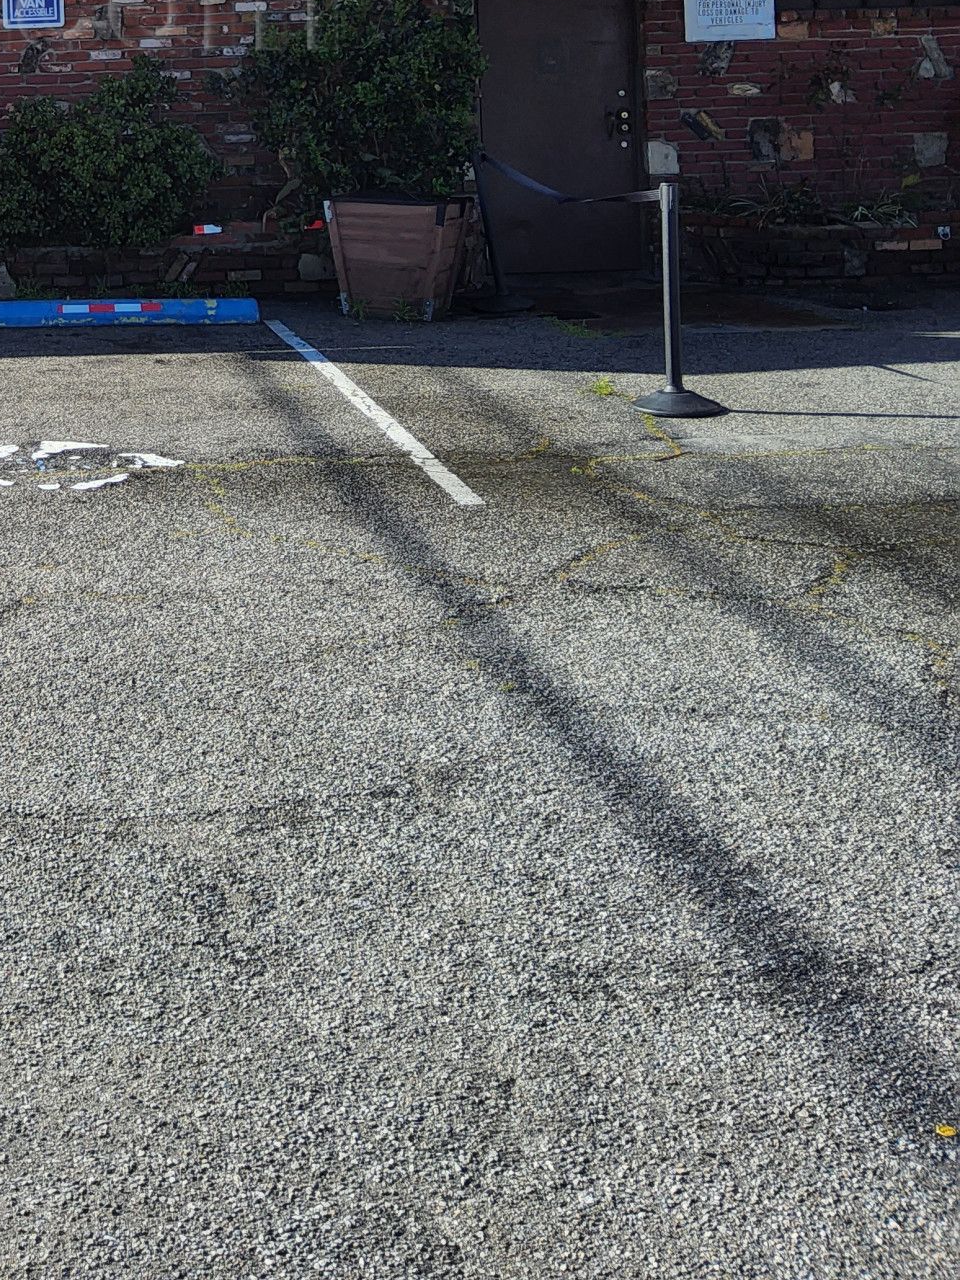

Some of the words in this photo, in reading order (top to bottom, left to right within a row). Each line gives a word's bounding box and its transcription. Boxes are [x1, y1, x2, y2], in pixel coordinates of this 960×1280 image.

[698, 1, 710, 9] FOR
[712, 0, 742, 8] PERSONAL
[745, 0, 766, 8] INJURY
[14, 7, 54, 17] ACCESSIBLE
[698, 9, 714, 17] LOSS
[725, 7, 748, 16] DAMAGE
[751, 7, 760, 15] TO
[711, 16, 744, 24] VEHICLES
